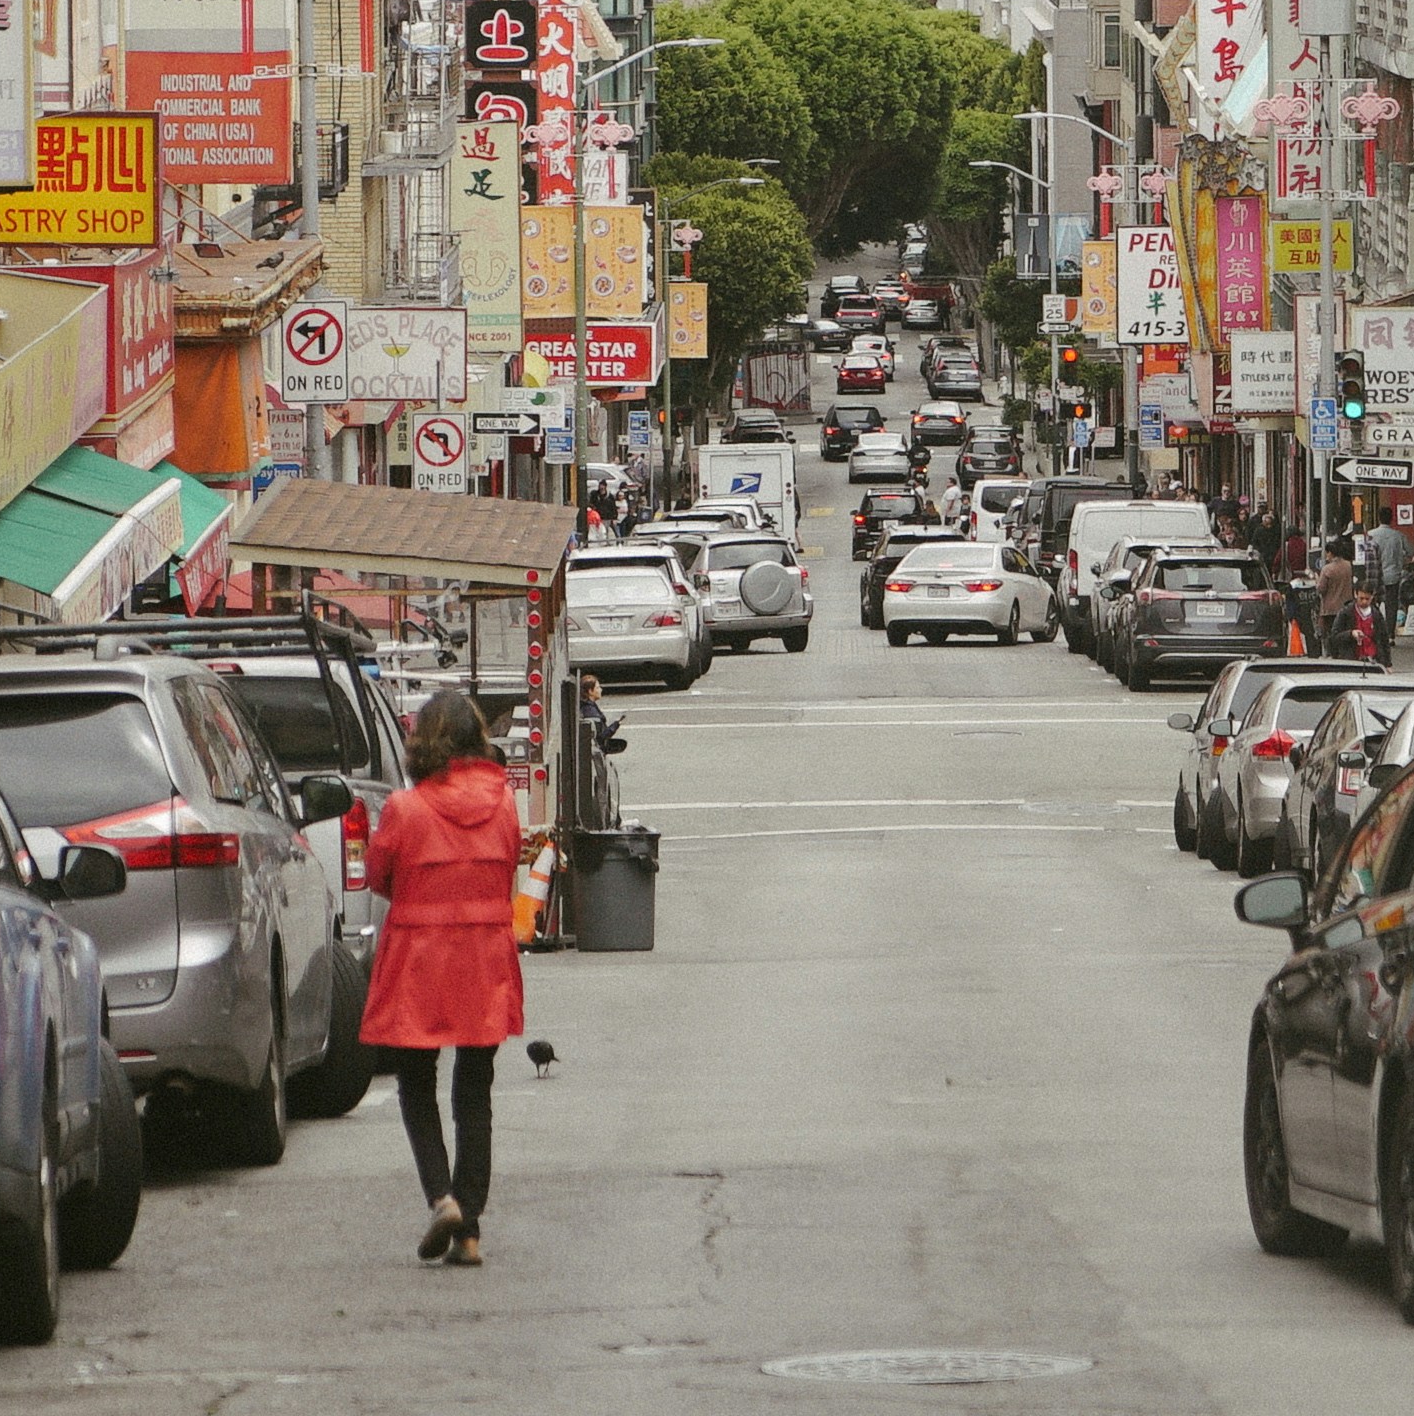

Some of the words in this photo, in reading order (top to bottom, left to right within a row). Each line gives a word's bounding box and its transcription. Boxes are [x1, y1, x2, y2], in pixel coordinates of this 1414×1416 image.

[161, 74, 224, 92] INDUSTRIAL
[228, 74, 251, 91] AND
[154, 99, 225, 116] COMMERCIAL
[231, 99, 261, 115] BANK
[163, 123, 179, 140] OF
[184, 123, 216, 141] CHINA
[162, 148, 198, 165] TIONAL
[202, 148, 274, 165] ASSOCIATION
[77, 210, 144, 233] SHOP
[1045, 309, 1063, 320] 25
[490, 333, 512, 342] 2001
[525, 341, 577, 358] GREA
[588, 341, 637, 358] STAR
[287, 375, 307, 391] ON
[314, 375, 343, 390] RED
[1272, 372, 1286, 382] ART
[1165, 386, 1187, 396] and
[501, 419, 520, 427] WAY
[1356, 466, 1378, 477] ONE
[1381, 467, 1404, 478] WAY
[418, 474, 434, 486] ON
[439, 473, 462, 486] RED
